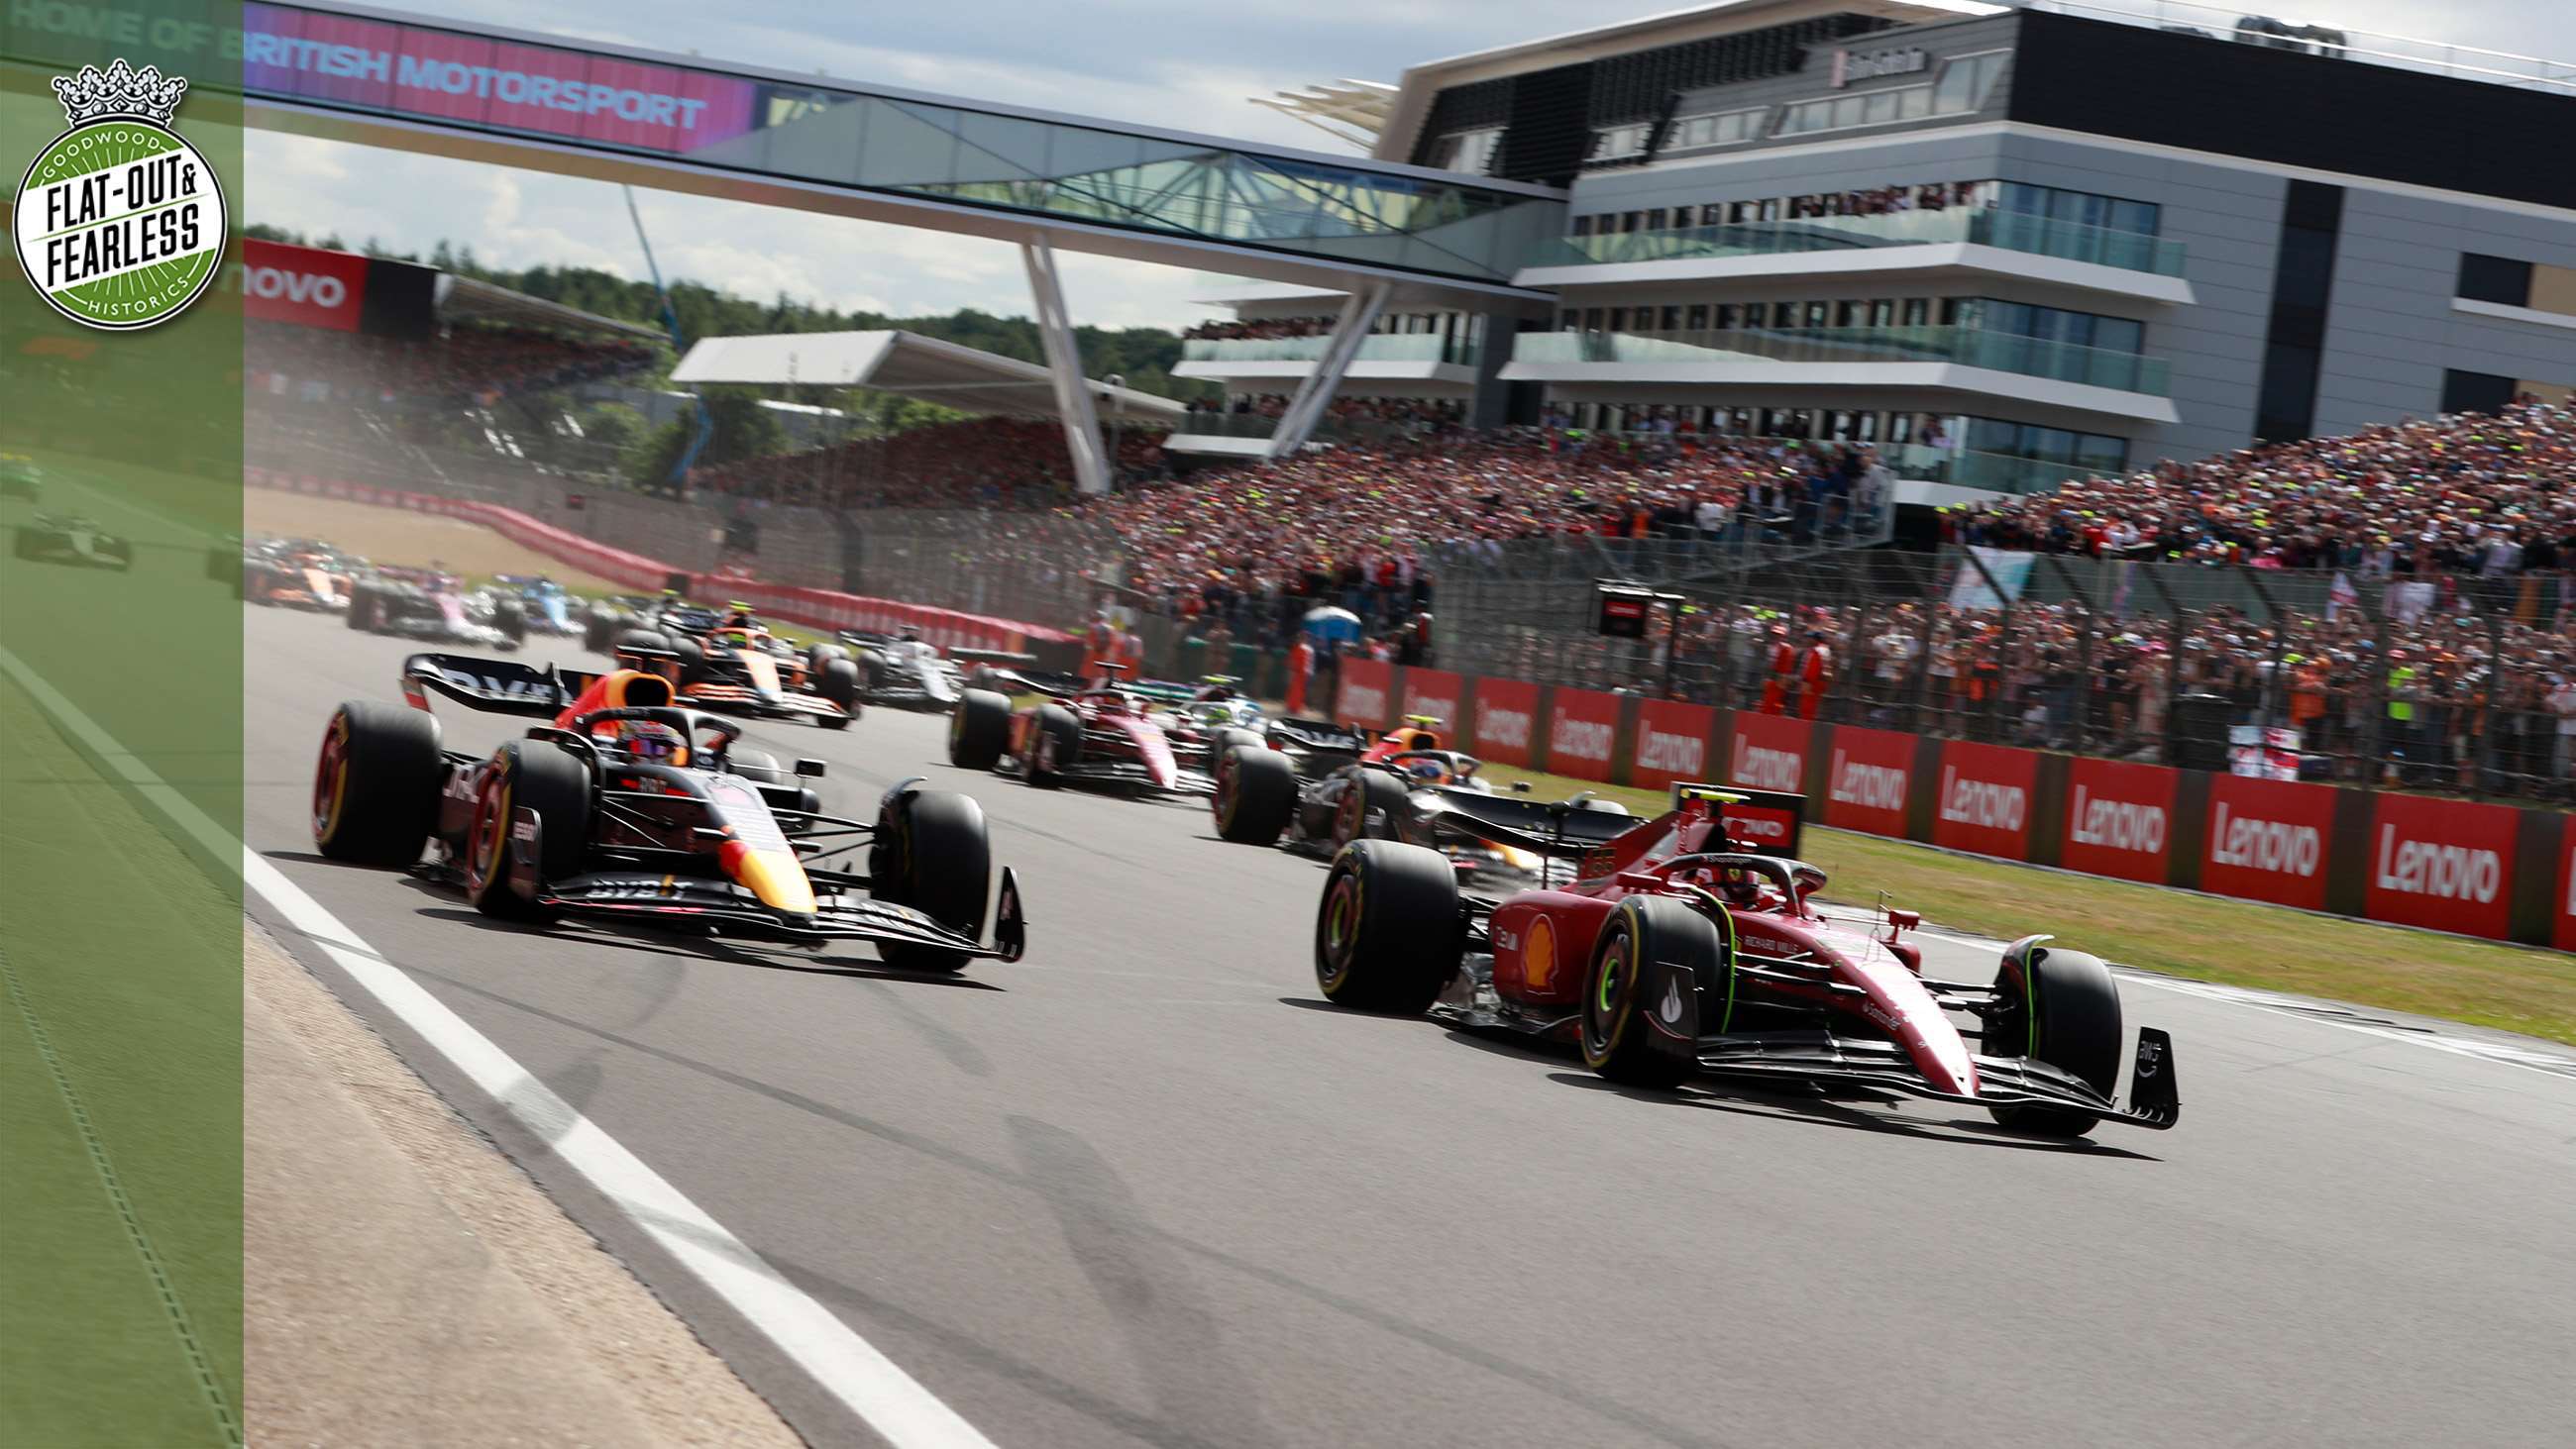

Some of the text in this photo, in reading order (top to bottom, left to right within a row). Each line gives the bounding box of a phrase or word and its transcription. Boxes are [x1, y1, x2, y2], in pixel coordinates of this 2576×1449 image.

[218, 27, 390, 83] BRITISH
[397, 54, 707, 130] MOTORSPORT
[1551, 705, 1614, 762] Lenovo
[1636, 718, 1704, 776] Lenovo
[1734, 732, 1802, 792] Lenovo
[1830, 748, 1906, 811] Lenovo
[1941, 764, 2026, 832] Lenovo
[2071, 783, 2167, 855] Lenovo
[2211, 800, 2320, 878] Lenovo
[2377, 822, 2501, 904] Lenovo
